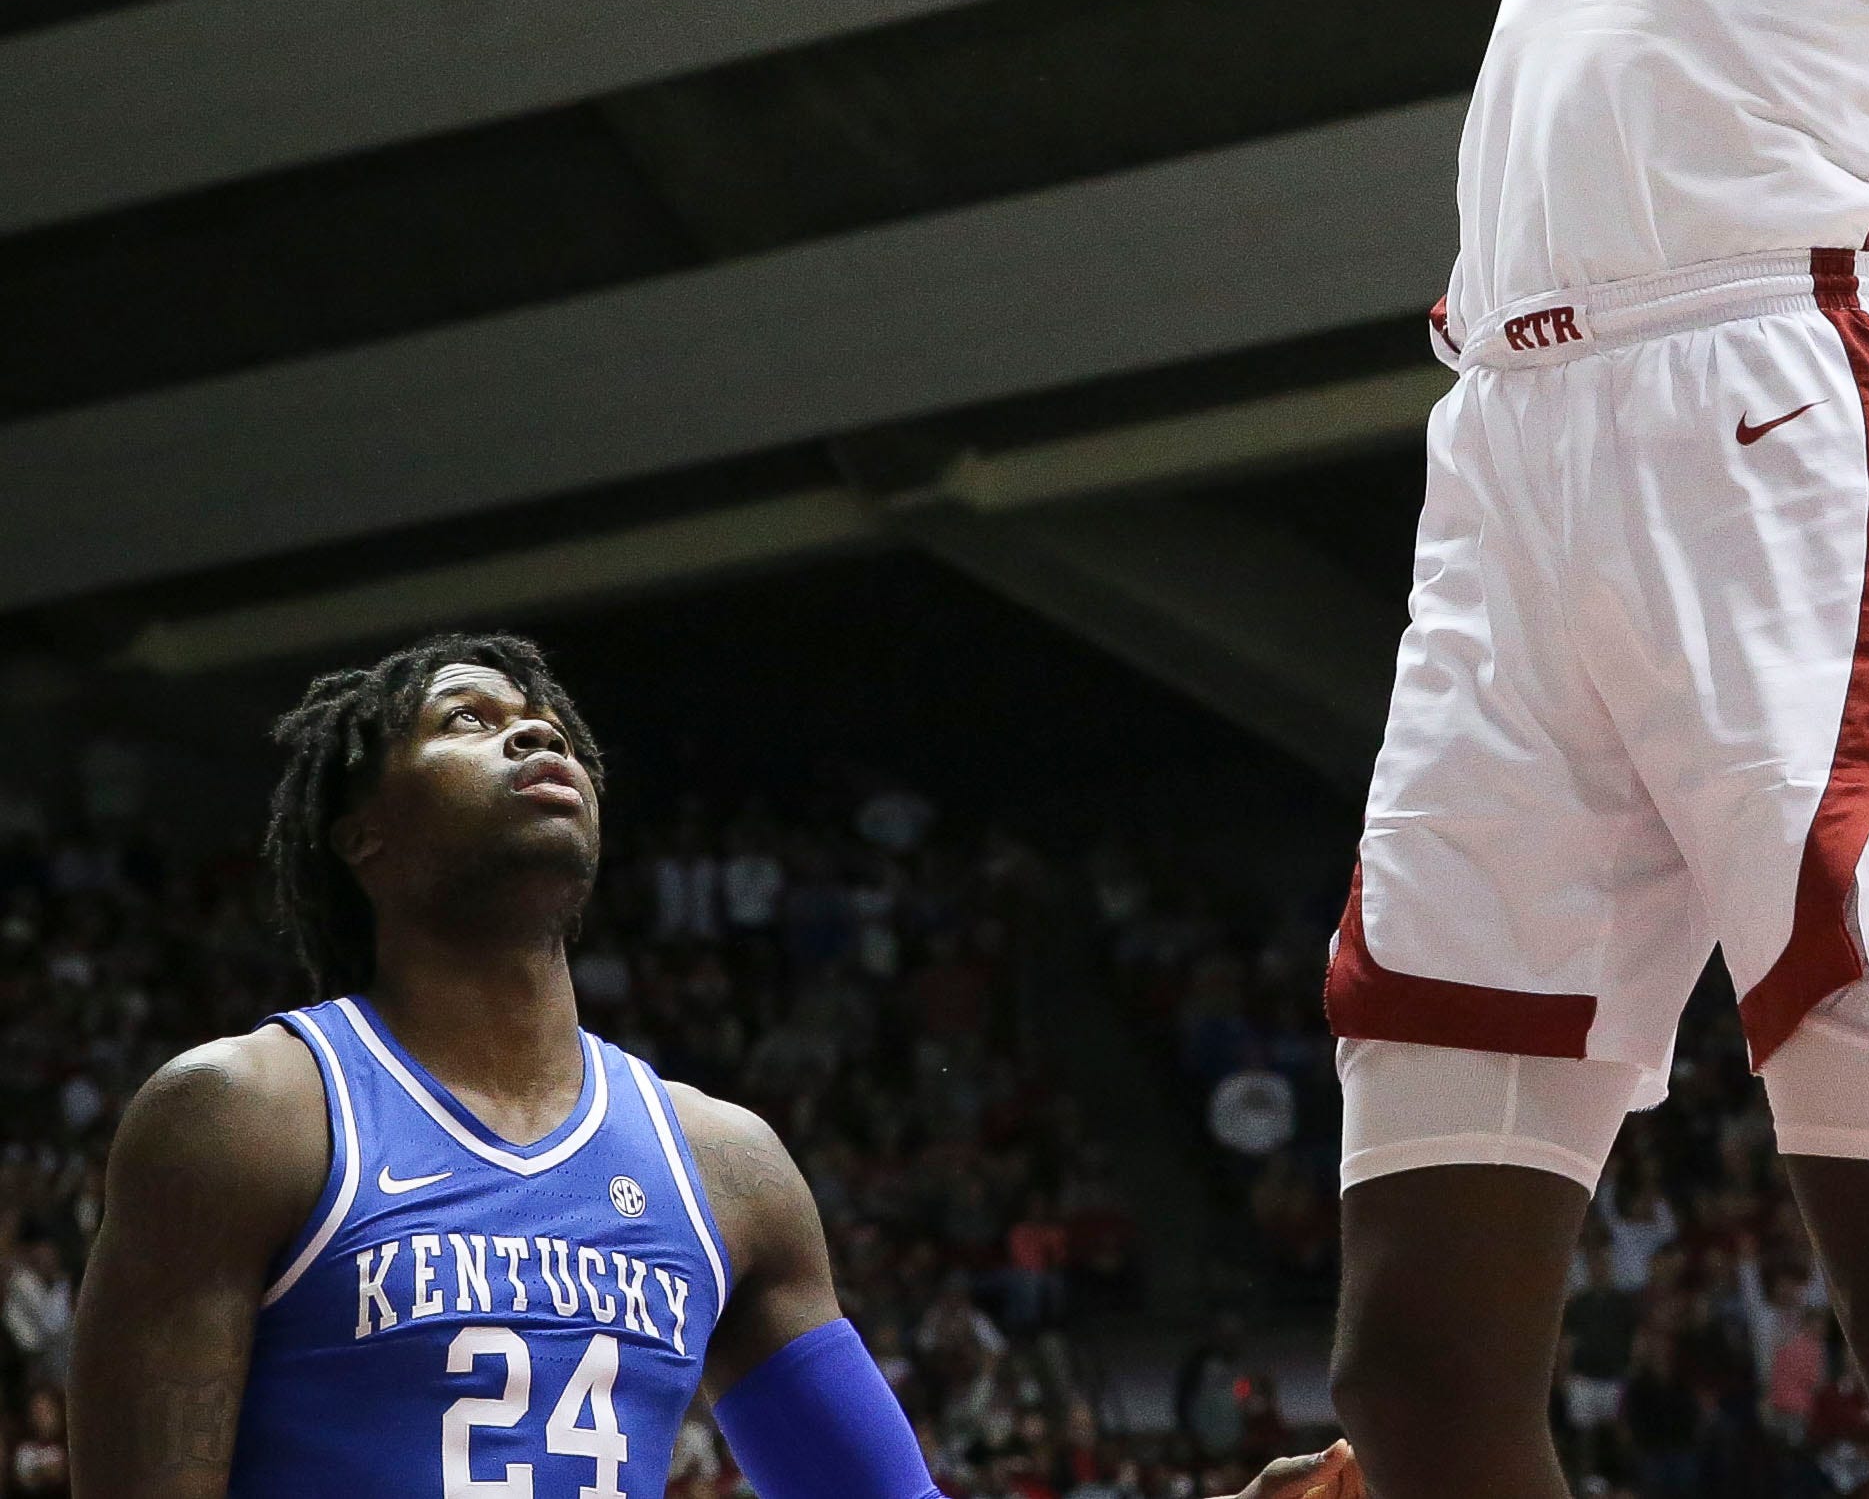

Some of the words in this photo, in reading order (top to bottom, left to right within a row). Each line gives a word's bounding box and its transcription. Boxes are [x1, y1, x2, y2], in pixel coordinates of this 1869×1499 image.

[1505, 305, 1582, 351] RTR
[611, 1179, 643, 1214] SEC
[355, 1234, 689, 1357] KENTUCKY
[442, 1327, 628, 1499] 24
